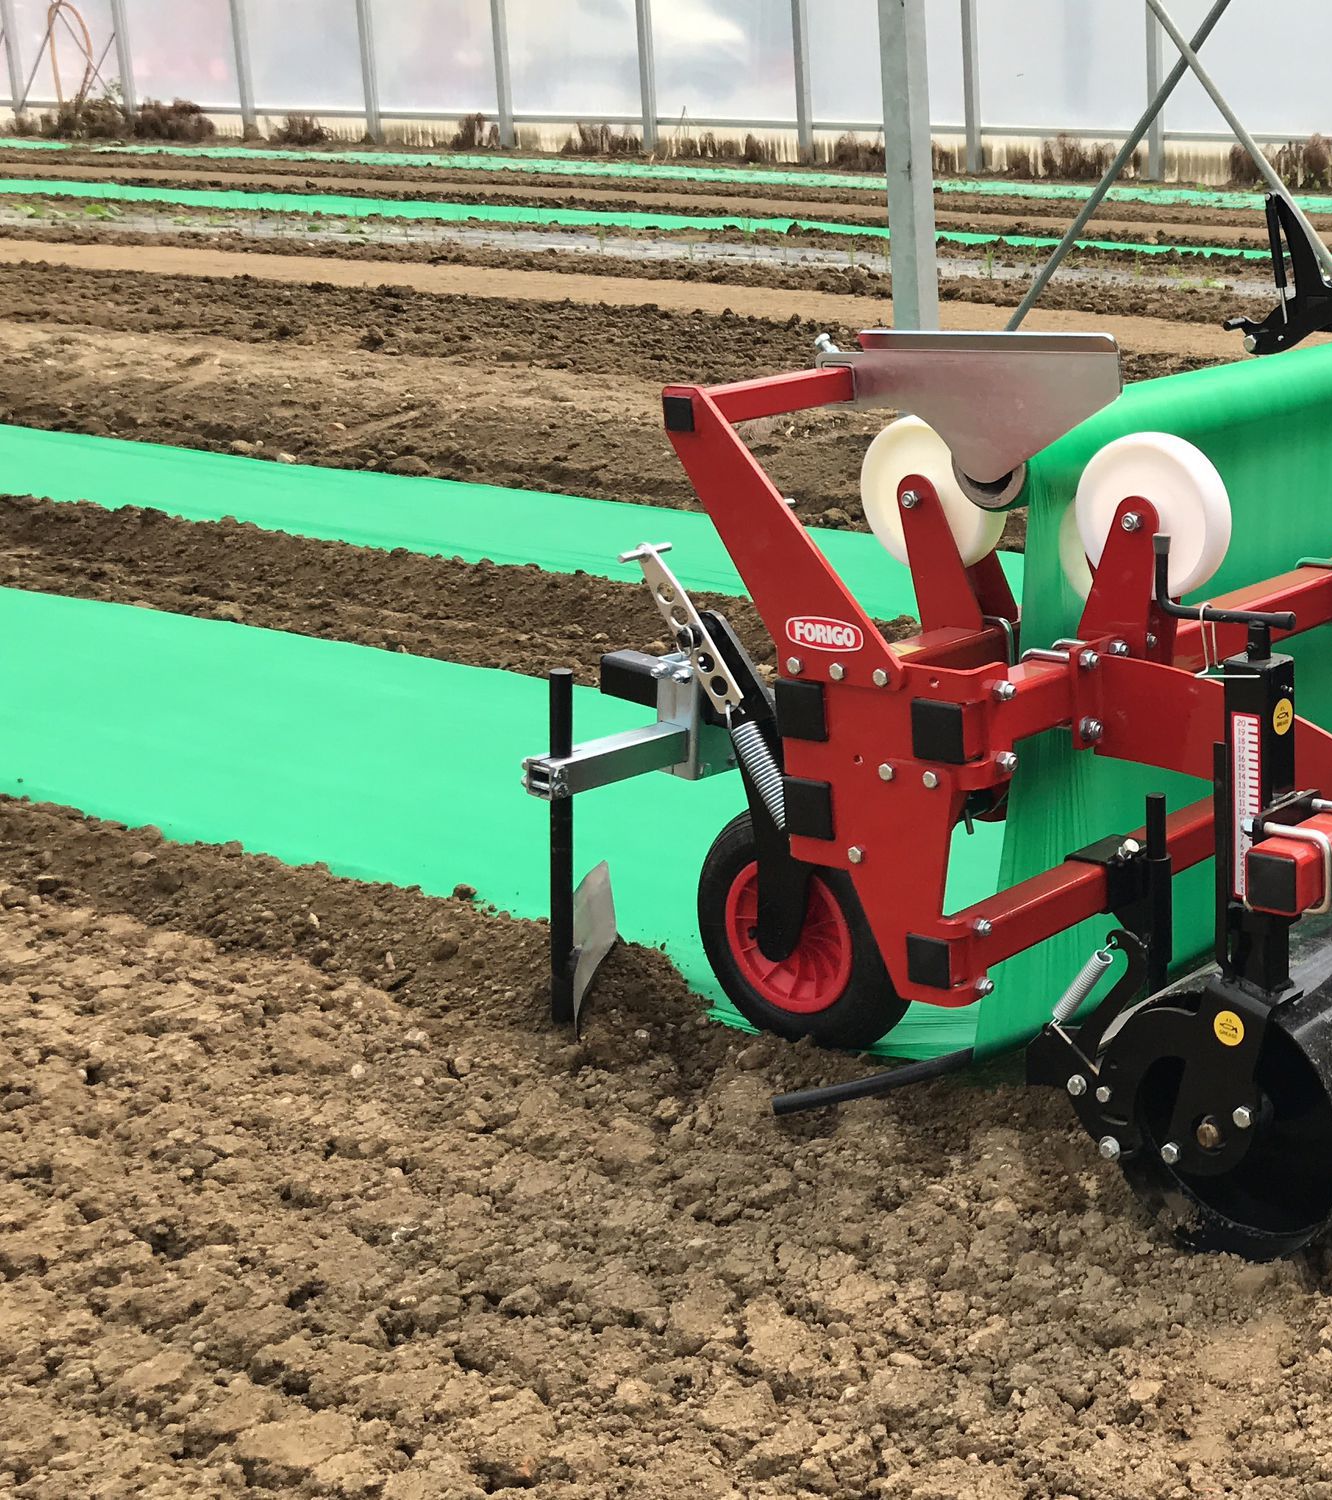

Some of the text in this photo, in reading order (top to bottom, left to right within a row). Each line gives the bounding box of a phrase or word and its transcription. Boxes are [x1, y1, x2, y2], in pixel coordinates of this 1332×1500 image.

[794, 621, 855, 647] FORIGO
[1237, 719, 1246, 727] 20
[1238, 746, 1246, 754] 17
[1238, 755, 1246, 763] 16
[1239, 799, 1246, 807] 11
[1239, 808, 1246, 816] 10
